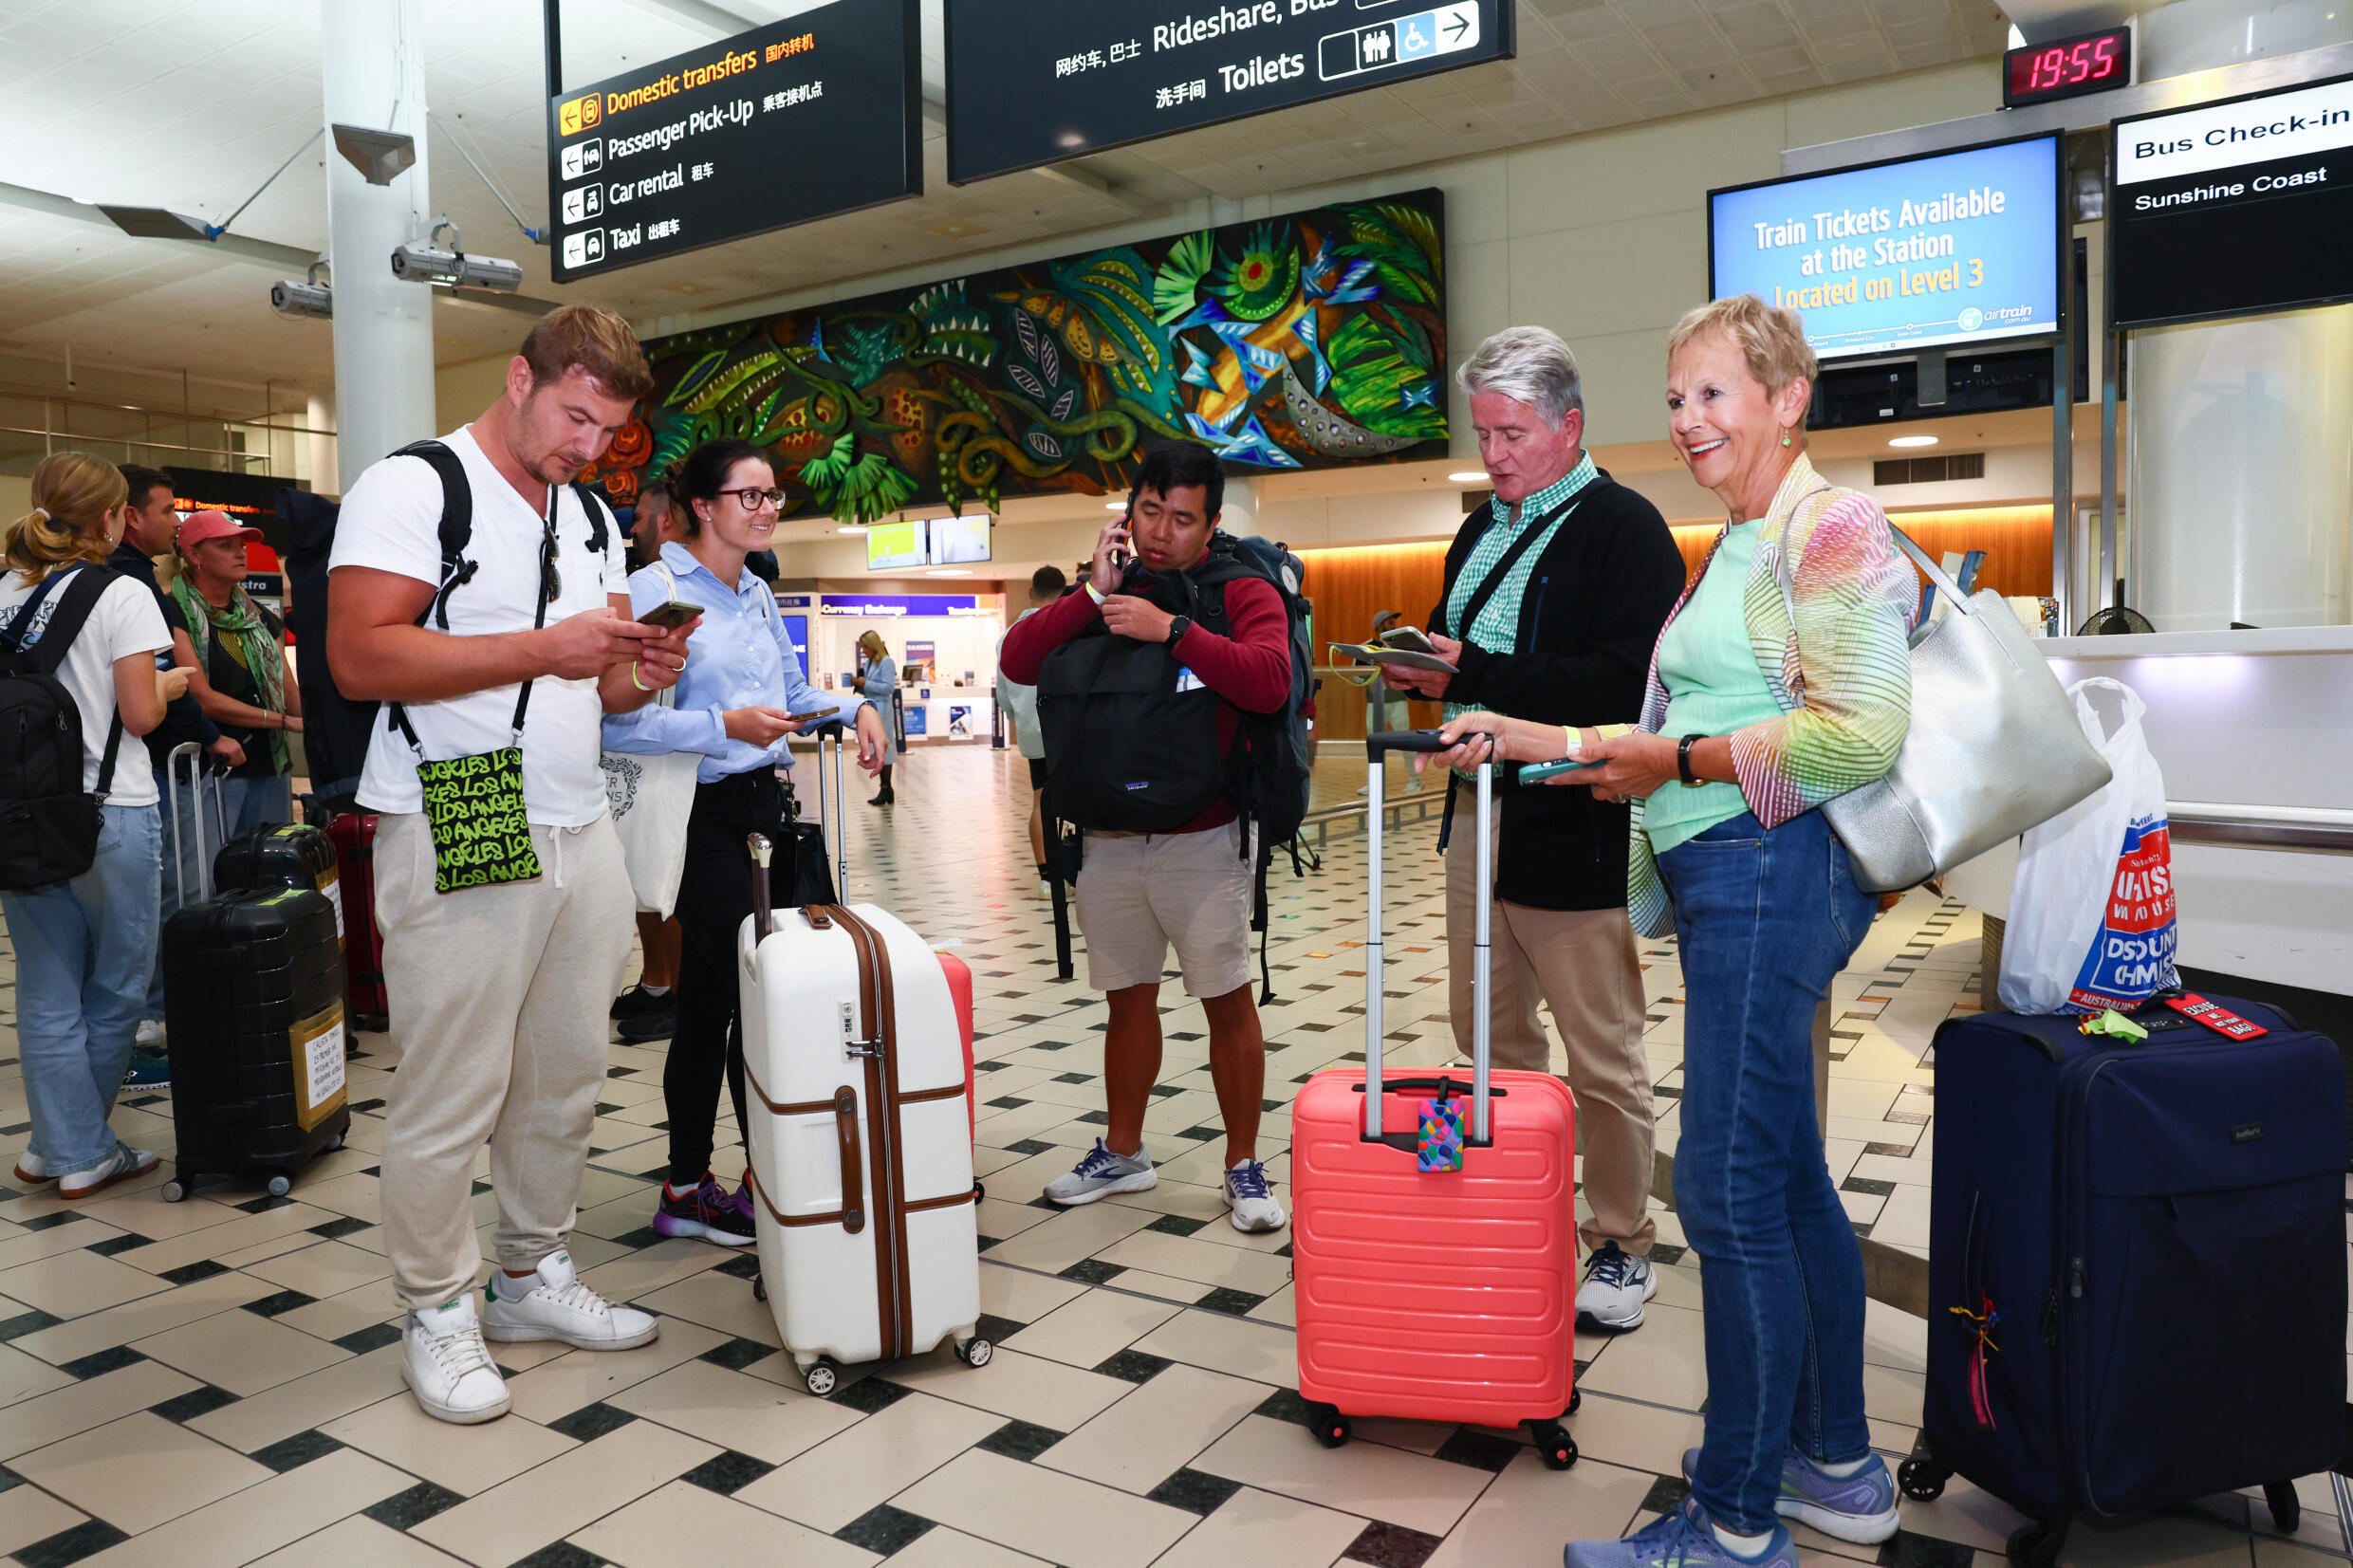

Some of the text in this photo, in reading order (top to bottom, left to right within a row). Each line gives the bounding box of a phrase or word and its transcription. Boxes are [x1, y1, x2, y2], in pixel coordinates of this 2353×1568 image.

[1154, 0, 1282, 52] Rideshare,
[766, 32, 814, 64] 国内转机
[1109, 39, 1141, 64] 巴士
[2030, 37, 2115, 88] 19:55
[607, 48, 757, 115] Domestic transfers
[1218, 52, 1305, 94] Toilets
[763, 81, 823, 113] 乘客接机点
[1156, 80, 1206, 109] 洗手间
[608, 99, 754, 160] Passenger Pick-Up
[2135, 108, 2350, 159] Bus Check-in
[609, 163, 683, 206] Car rental
[692, 162, 713, 182] 租车
[2135, 167, 2327, 211] Sunshine Coast
[648, 218, 680, 241] 出租车
[1754, 187, 2006, 249] Train Tickets Available
[610, 223, 640, 251] Taxi
[1801, 233, 1954, 276] at the Station
[1775, 259, 1984, 310] Located on Level 3
[1984, 304, 2032, 322] airtrain
[195, 501, 229, 511] Domestic
[463, 776, 500, 796] LOS
[435, 801, 471, 825] LOS
[454, 811, 528, 840] ANGELES
[451, 868, 489, 887] LOS
